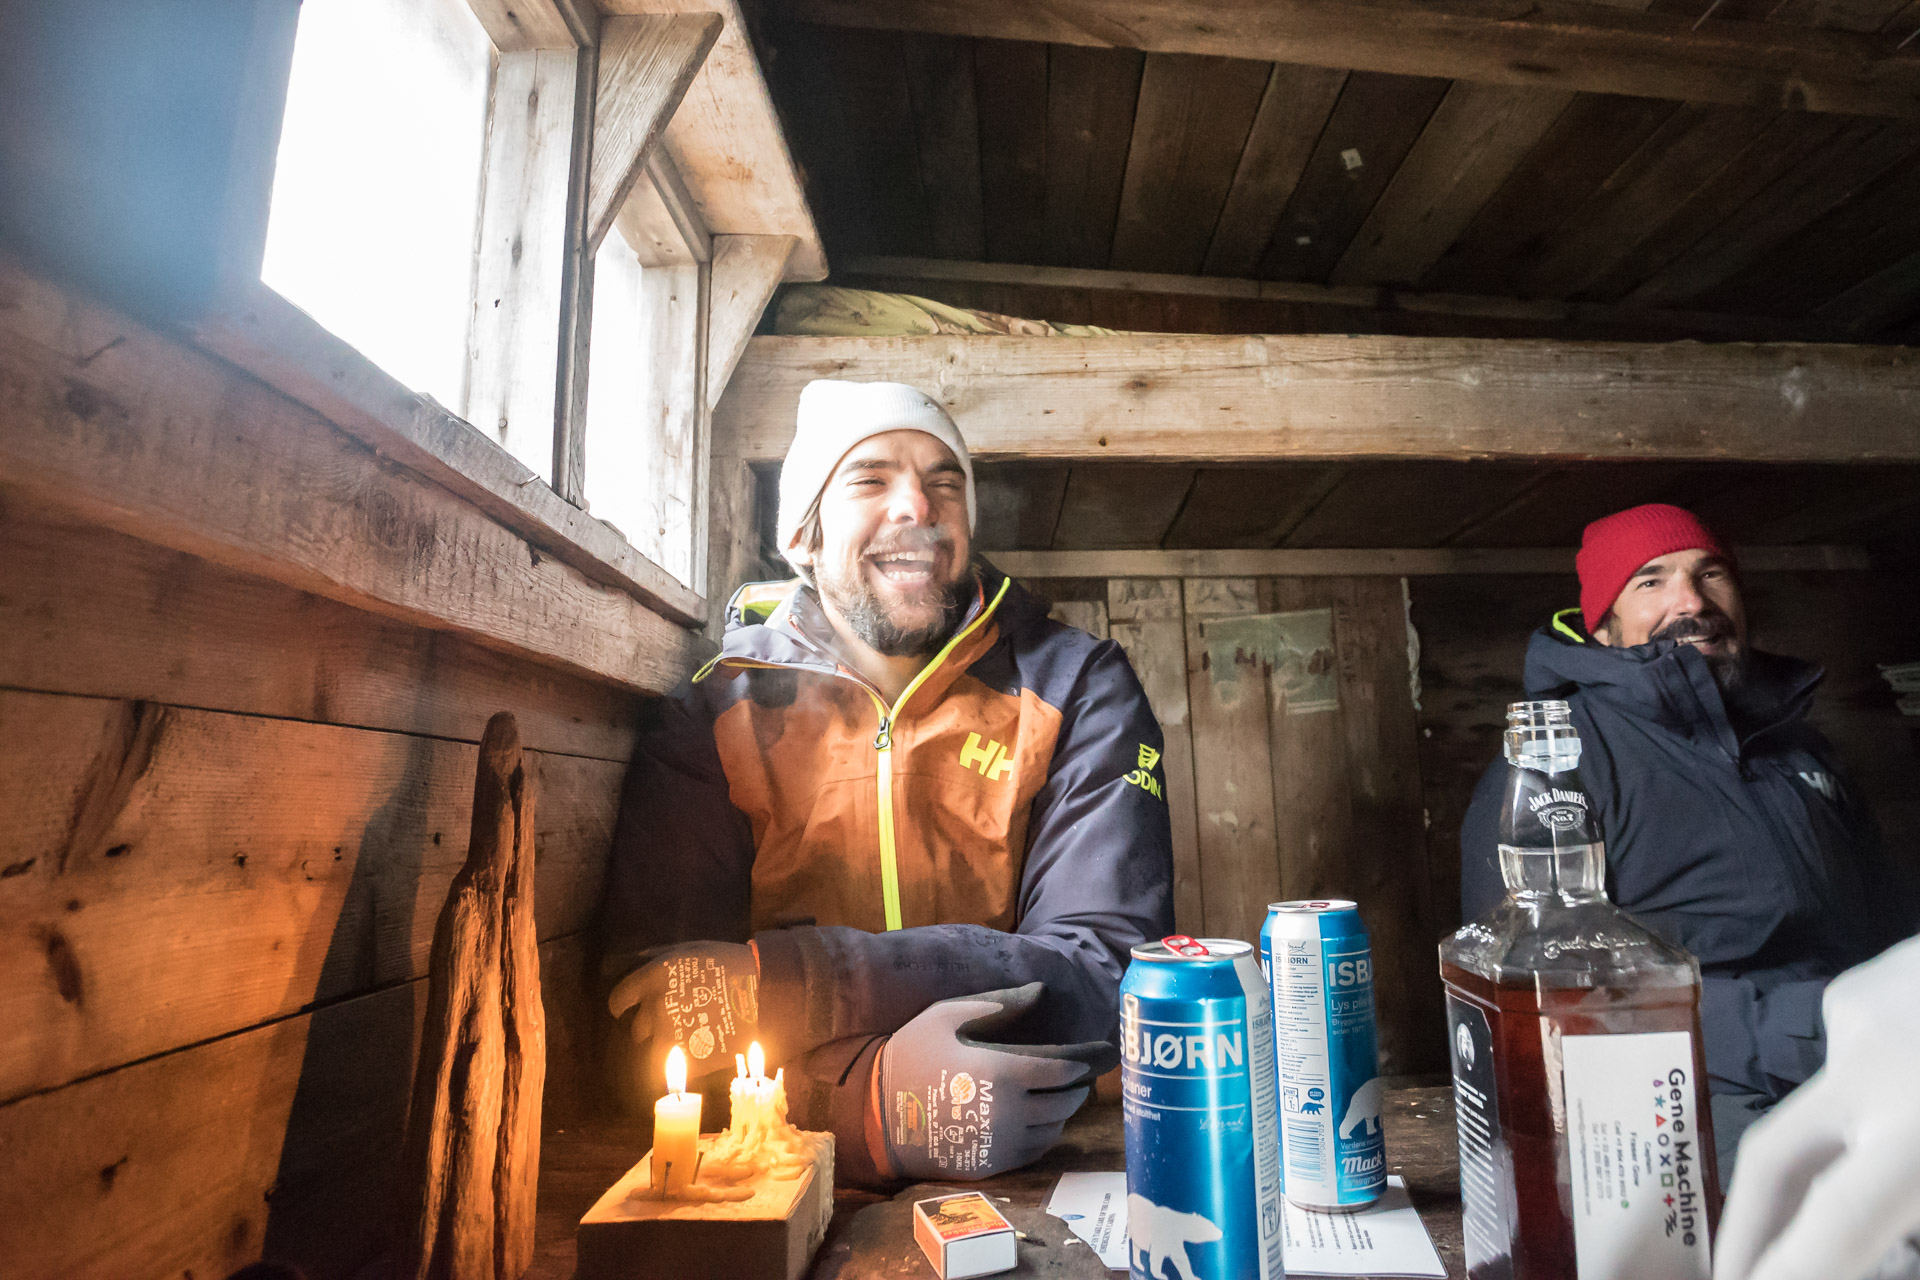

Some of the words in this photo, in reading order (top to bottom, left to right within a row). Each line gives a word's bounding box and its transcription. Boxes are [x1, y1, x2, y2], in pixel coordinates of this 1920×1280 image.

[959, 732, 1015, 781] HH
[1122, 769, 1162, 801] ODIN
[1528, 792, 1554, 812] JACK
[1276, 955, 1309, 965] ISJØRN
[664, 964, 685, 1050] axiFlex
[1331, 998, 1350, 1014] Lys
[1668, 1067, 1686, 1133] Gene
[979, 1079, 993, 1167] MaxiFlex
[1341, 1150, 1383, 1174] Mack
[1673, 1140, 1698, 1248] Machine
